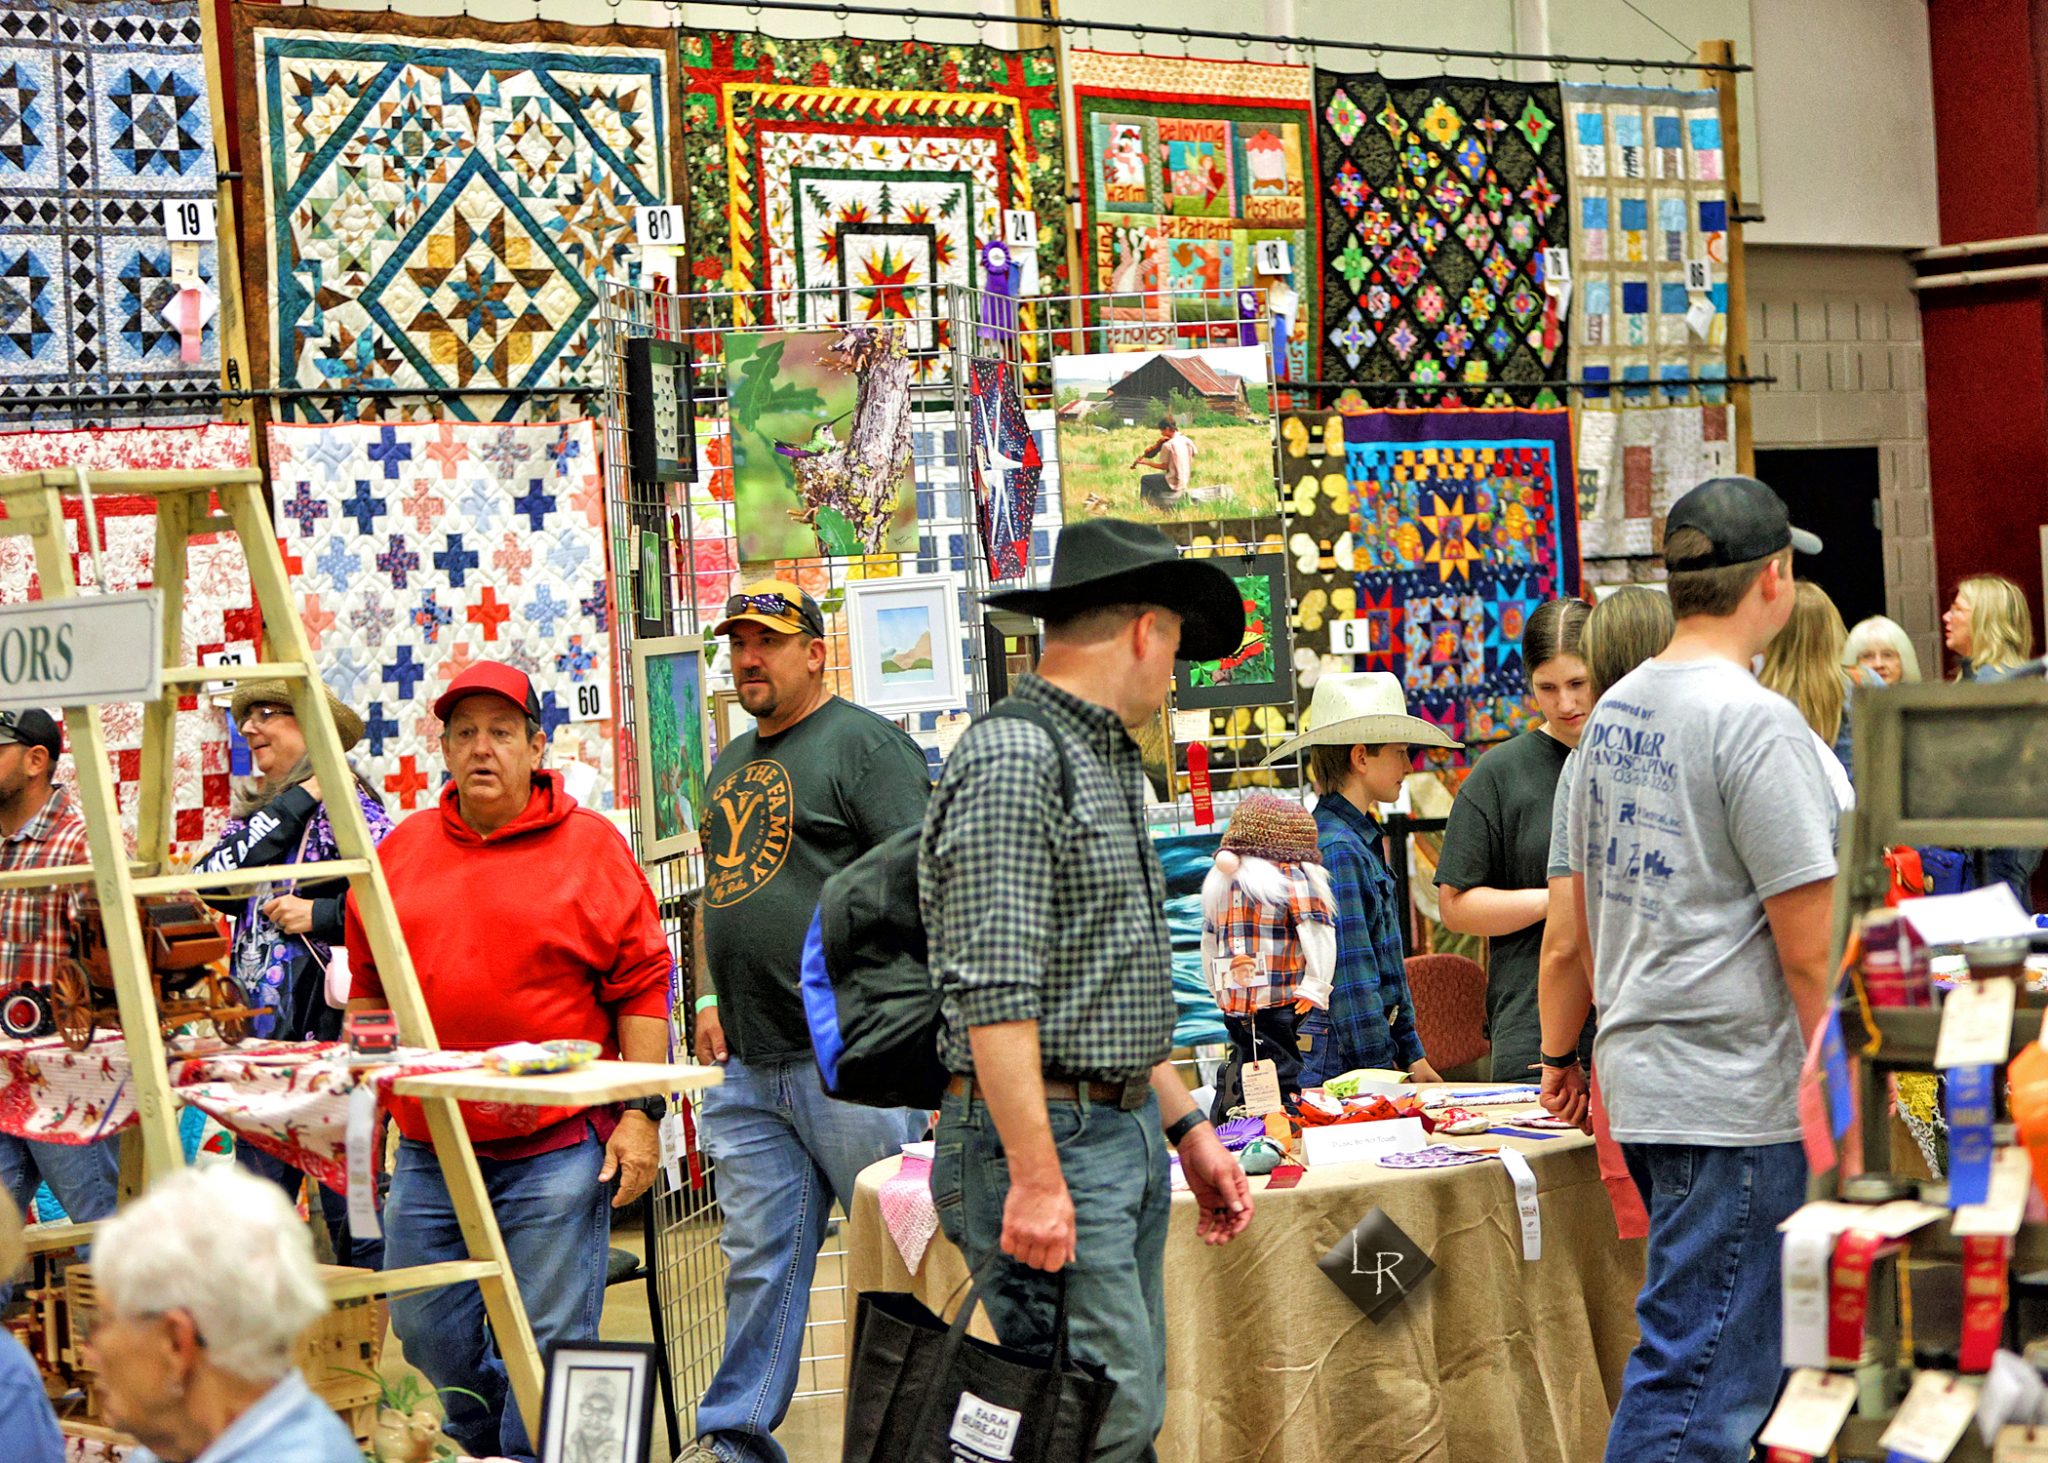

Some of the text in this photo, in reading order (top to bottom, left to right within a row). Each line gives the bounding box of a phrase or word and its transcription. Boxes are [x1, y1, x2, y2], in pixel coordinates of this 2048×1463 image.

[176, 202, 201, 236] 19
[647, 209, 672, 240] 80
[1011, 213, 1028, 242] 24
[1344, 622, 1355, 649] 6
[578, 685, 600, 716] 60
[713, 764, 788, 883] OF THE FAMILY
[961, 1413, 1008, 1440] BUREAU
[976, 1407, 1009, 1429] FARM
